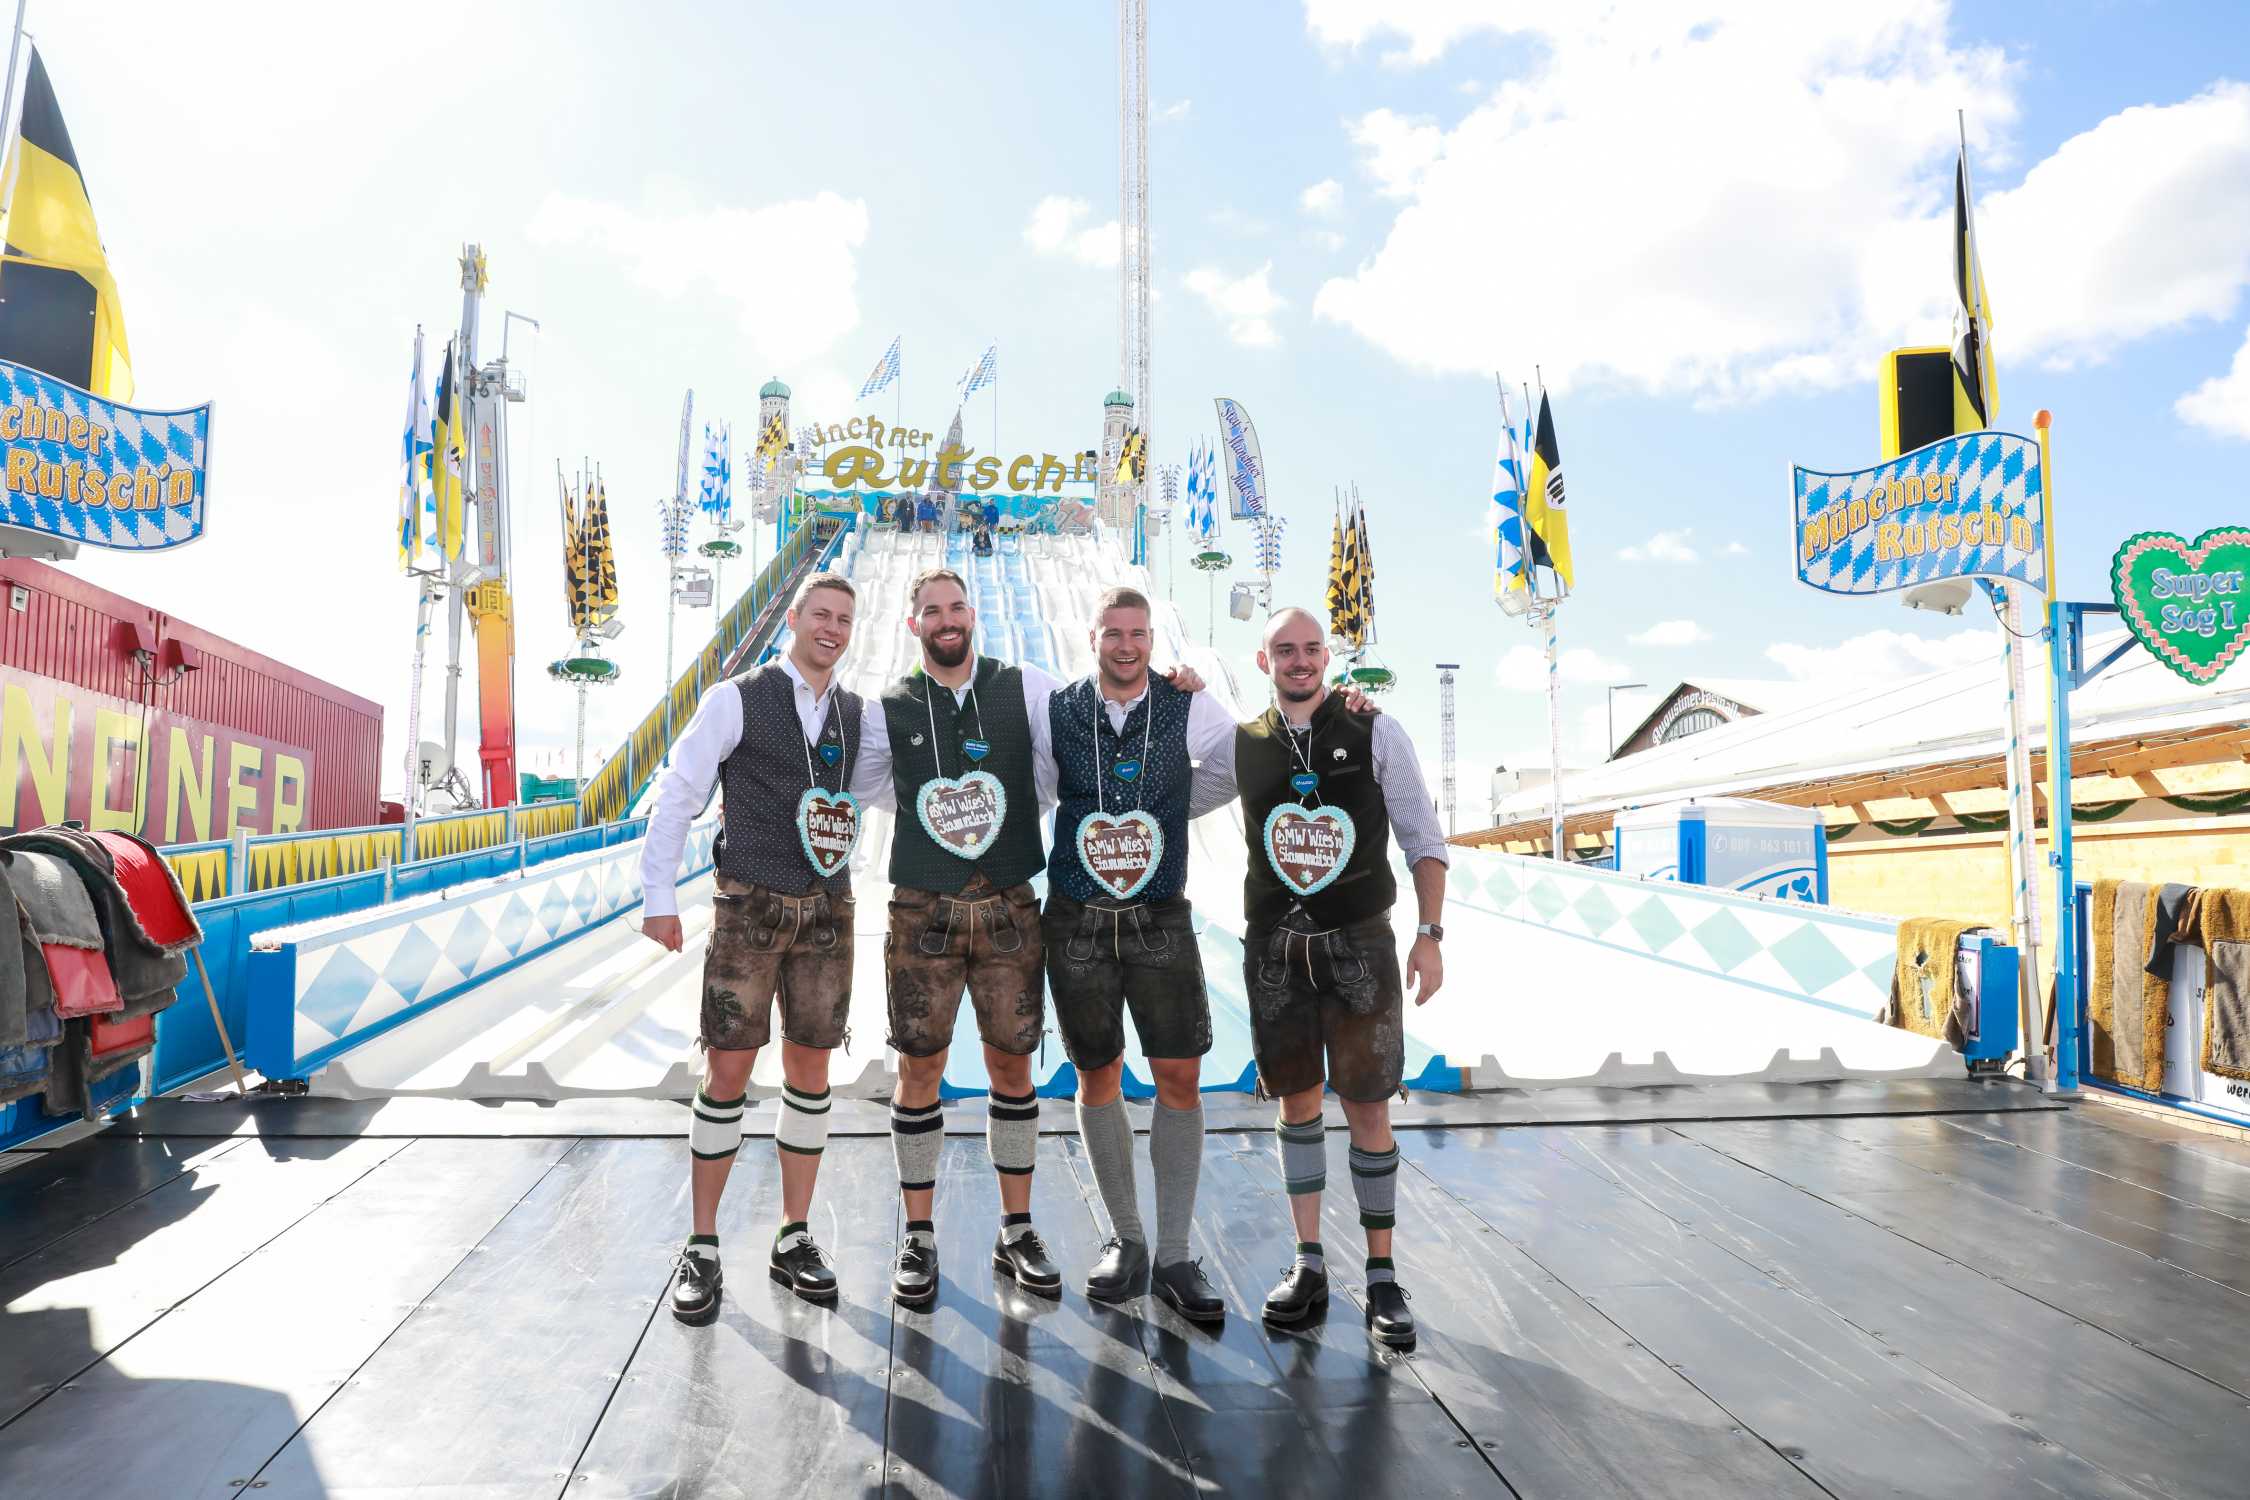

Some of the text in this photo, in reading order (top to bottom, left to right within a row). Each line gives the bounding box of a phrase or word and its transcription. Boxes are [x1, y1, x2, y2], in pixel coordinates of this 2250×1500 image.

[6, 447, 195, 512] Rutsch'n
[1803, 472, 1959, 562] Münchner
[1875, 502, 2035, 563] Rutsch'n
[2151, 567, 2245, 604] Super
[2160, 604, 2217, 638] Sog
[928, 792, 997, 818] BMW Wies'n
[1086, 837, 1116, 856] BMW
[1275, 827, 1343, 849] BMW Wies'n
